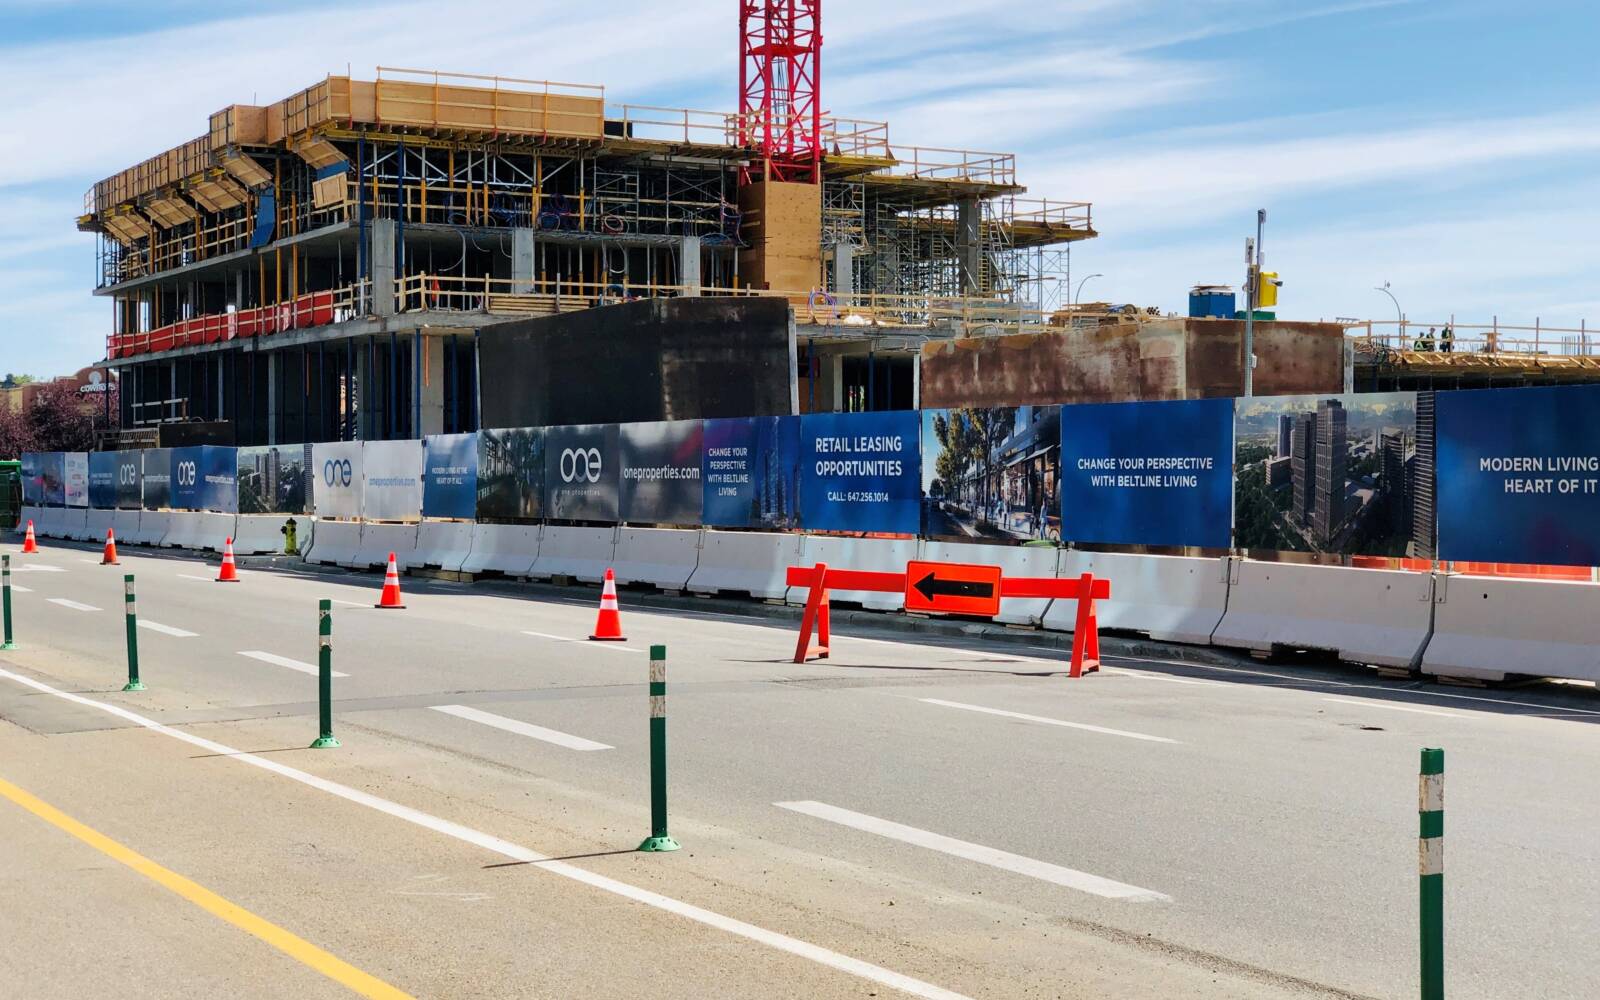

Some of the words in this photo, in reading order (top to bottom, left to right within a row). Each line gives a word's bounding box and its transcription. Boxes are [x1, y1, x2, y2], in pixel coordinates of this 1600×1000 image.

[815, 437, 851, 453] RETAIL
[854, 435, 902, 452] LEASING
[708, 447, 731, 456] CHANGE
[732, 447, 748, 456] YOUR
[710, 460, 746, 470] PERSPECTIVE
[815, 460, 902, 476] OPPORTUNITIES
[1077, 458, 1116, 470] CHANGE
[1118, 458, 1144, 469] YOUR
[1147, 457, 1213, 469] PERSPECTIVE
[1480, 458, 1543, 471] MODERN
[1548, 457, 1599, 471] LIVING
[624, 464, 700, 482] oneproperties.com
[707, 474, 722, 483] WITH
[723, 474, 749, 483] BELTLINE
[1091, 475, 1115, 487] WITH
[1118, 475, 1161, 487] BELTLINE
[1164, 475, 1198, 487] LIVING
[1504, 479, 1553, 493] HEART
[1558, 479, 1579, 493] OF
[1584, 479, 1598, 493] IT
[718, 487, 737, 496] LIVING
[827, 491, 846, 501] CALL:
[847, 491, 889, 502] 647.256.1014
